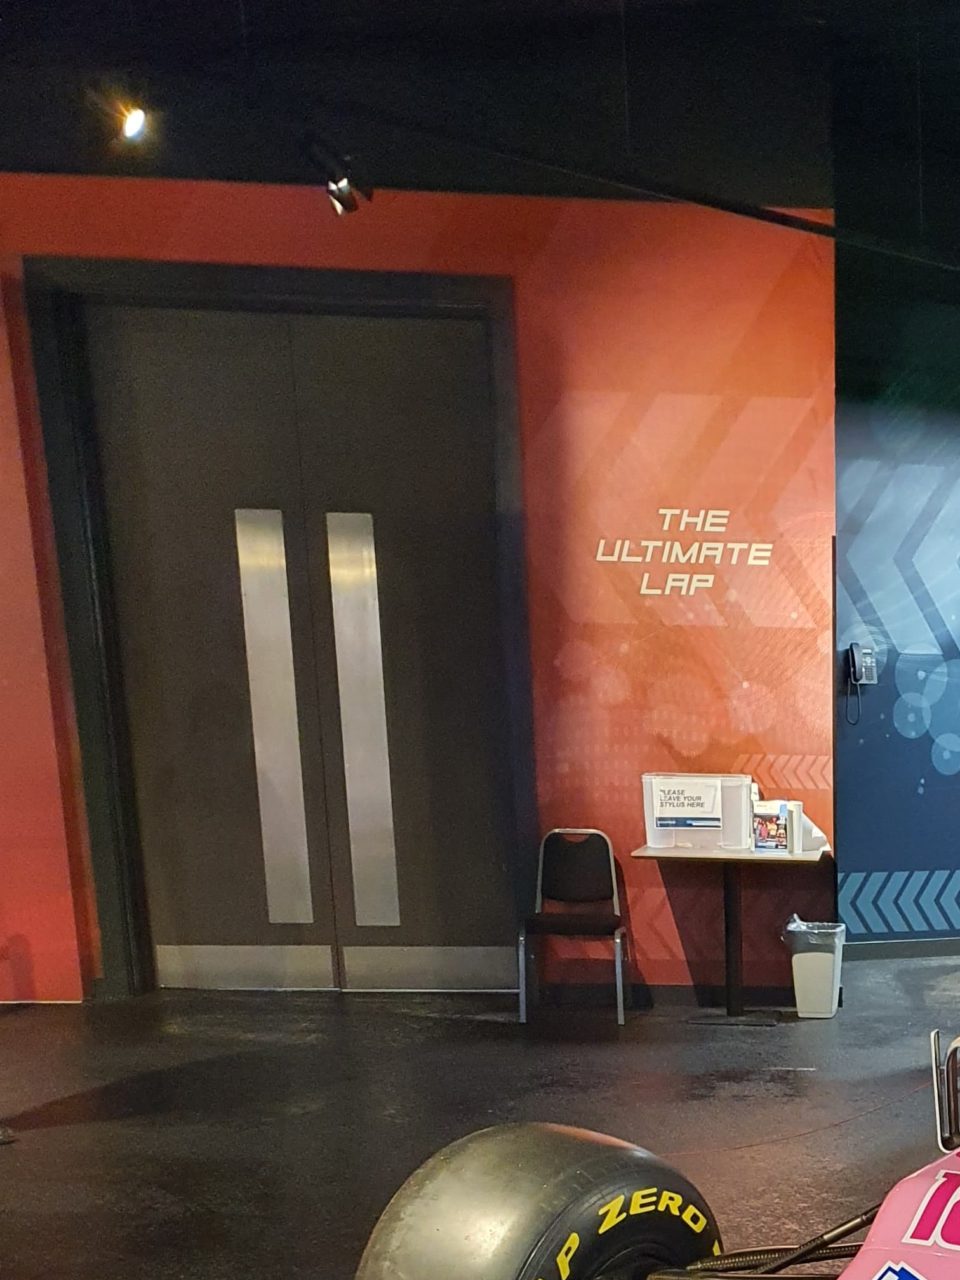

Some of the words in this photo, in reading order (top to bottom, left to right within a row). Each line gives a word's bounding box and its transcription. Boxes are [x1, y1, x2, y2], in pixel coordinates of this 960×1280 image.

[658, 508, 730, 532] THE
[596, 539, 773, 565] ULTIMATE
[640, 573, 715, 596] LAP
[598, 1187, 707, 1235] ZERO
